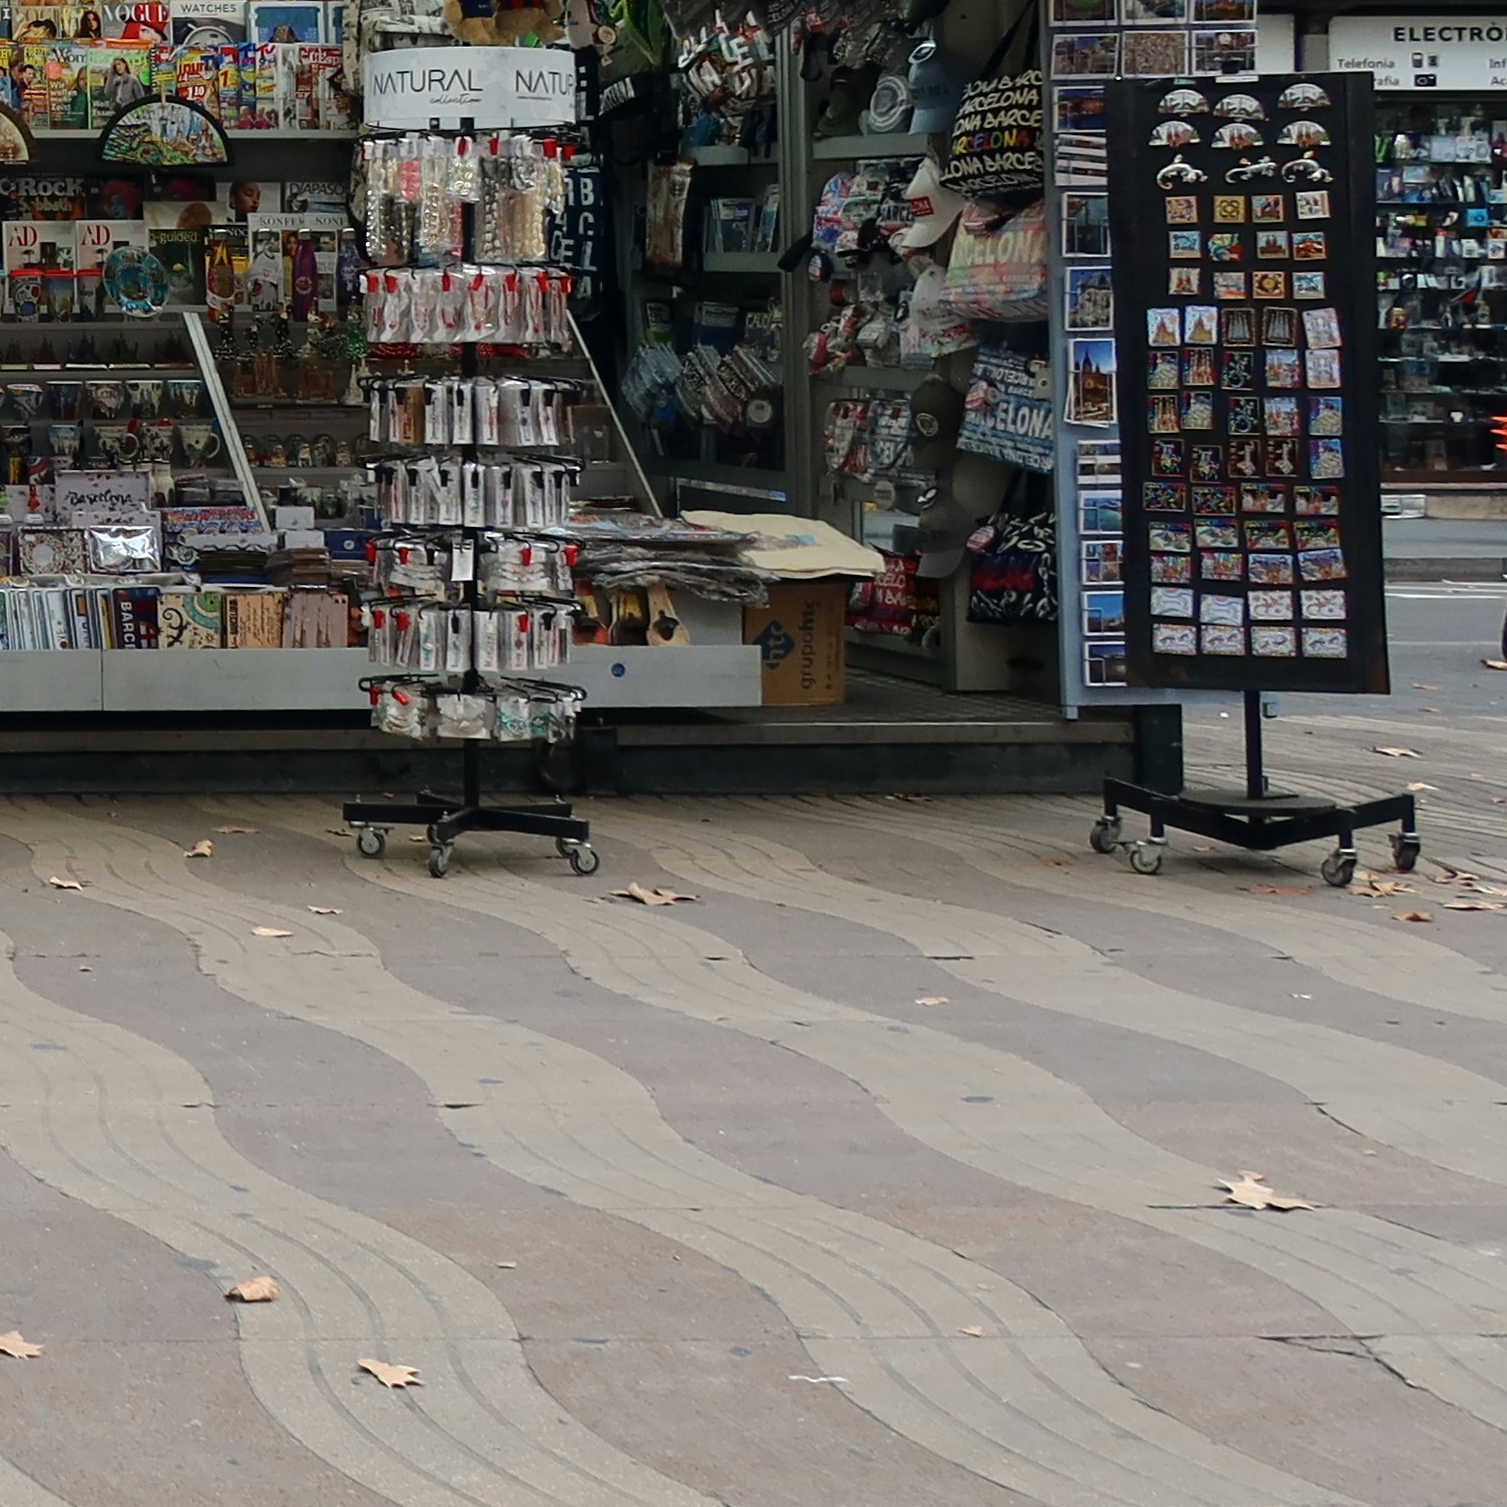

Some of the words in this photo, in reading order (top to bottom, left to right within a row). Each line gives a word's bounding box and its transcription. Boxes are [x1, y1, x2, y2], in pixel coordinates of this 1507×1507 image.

[102, 2, 171, 23] VOGUE
[180, 3, 237, 13] WATCHES
[374, 68, 483, 96] NATURAL
[288, 182, 347, 194] DIAPASO
[9, 225, 38, 247] AD
[82, 224, 113, 246] AD
